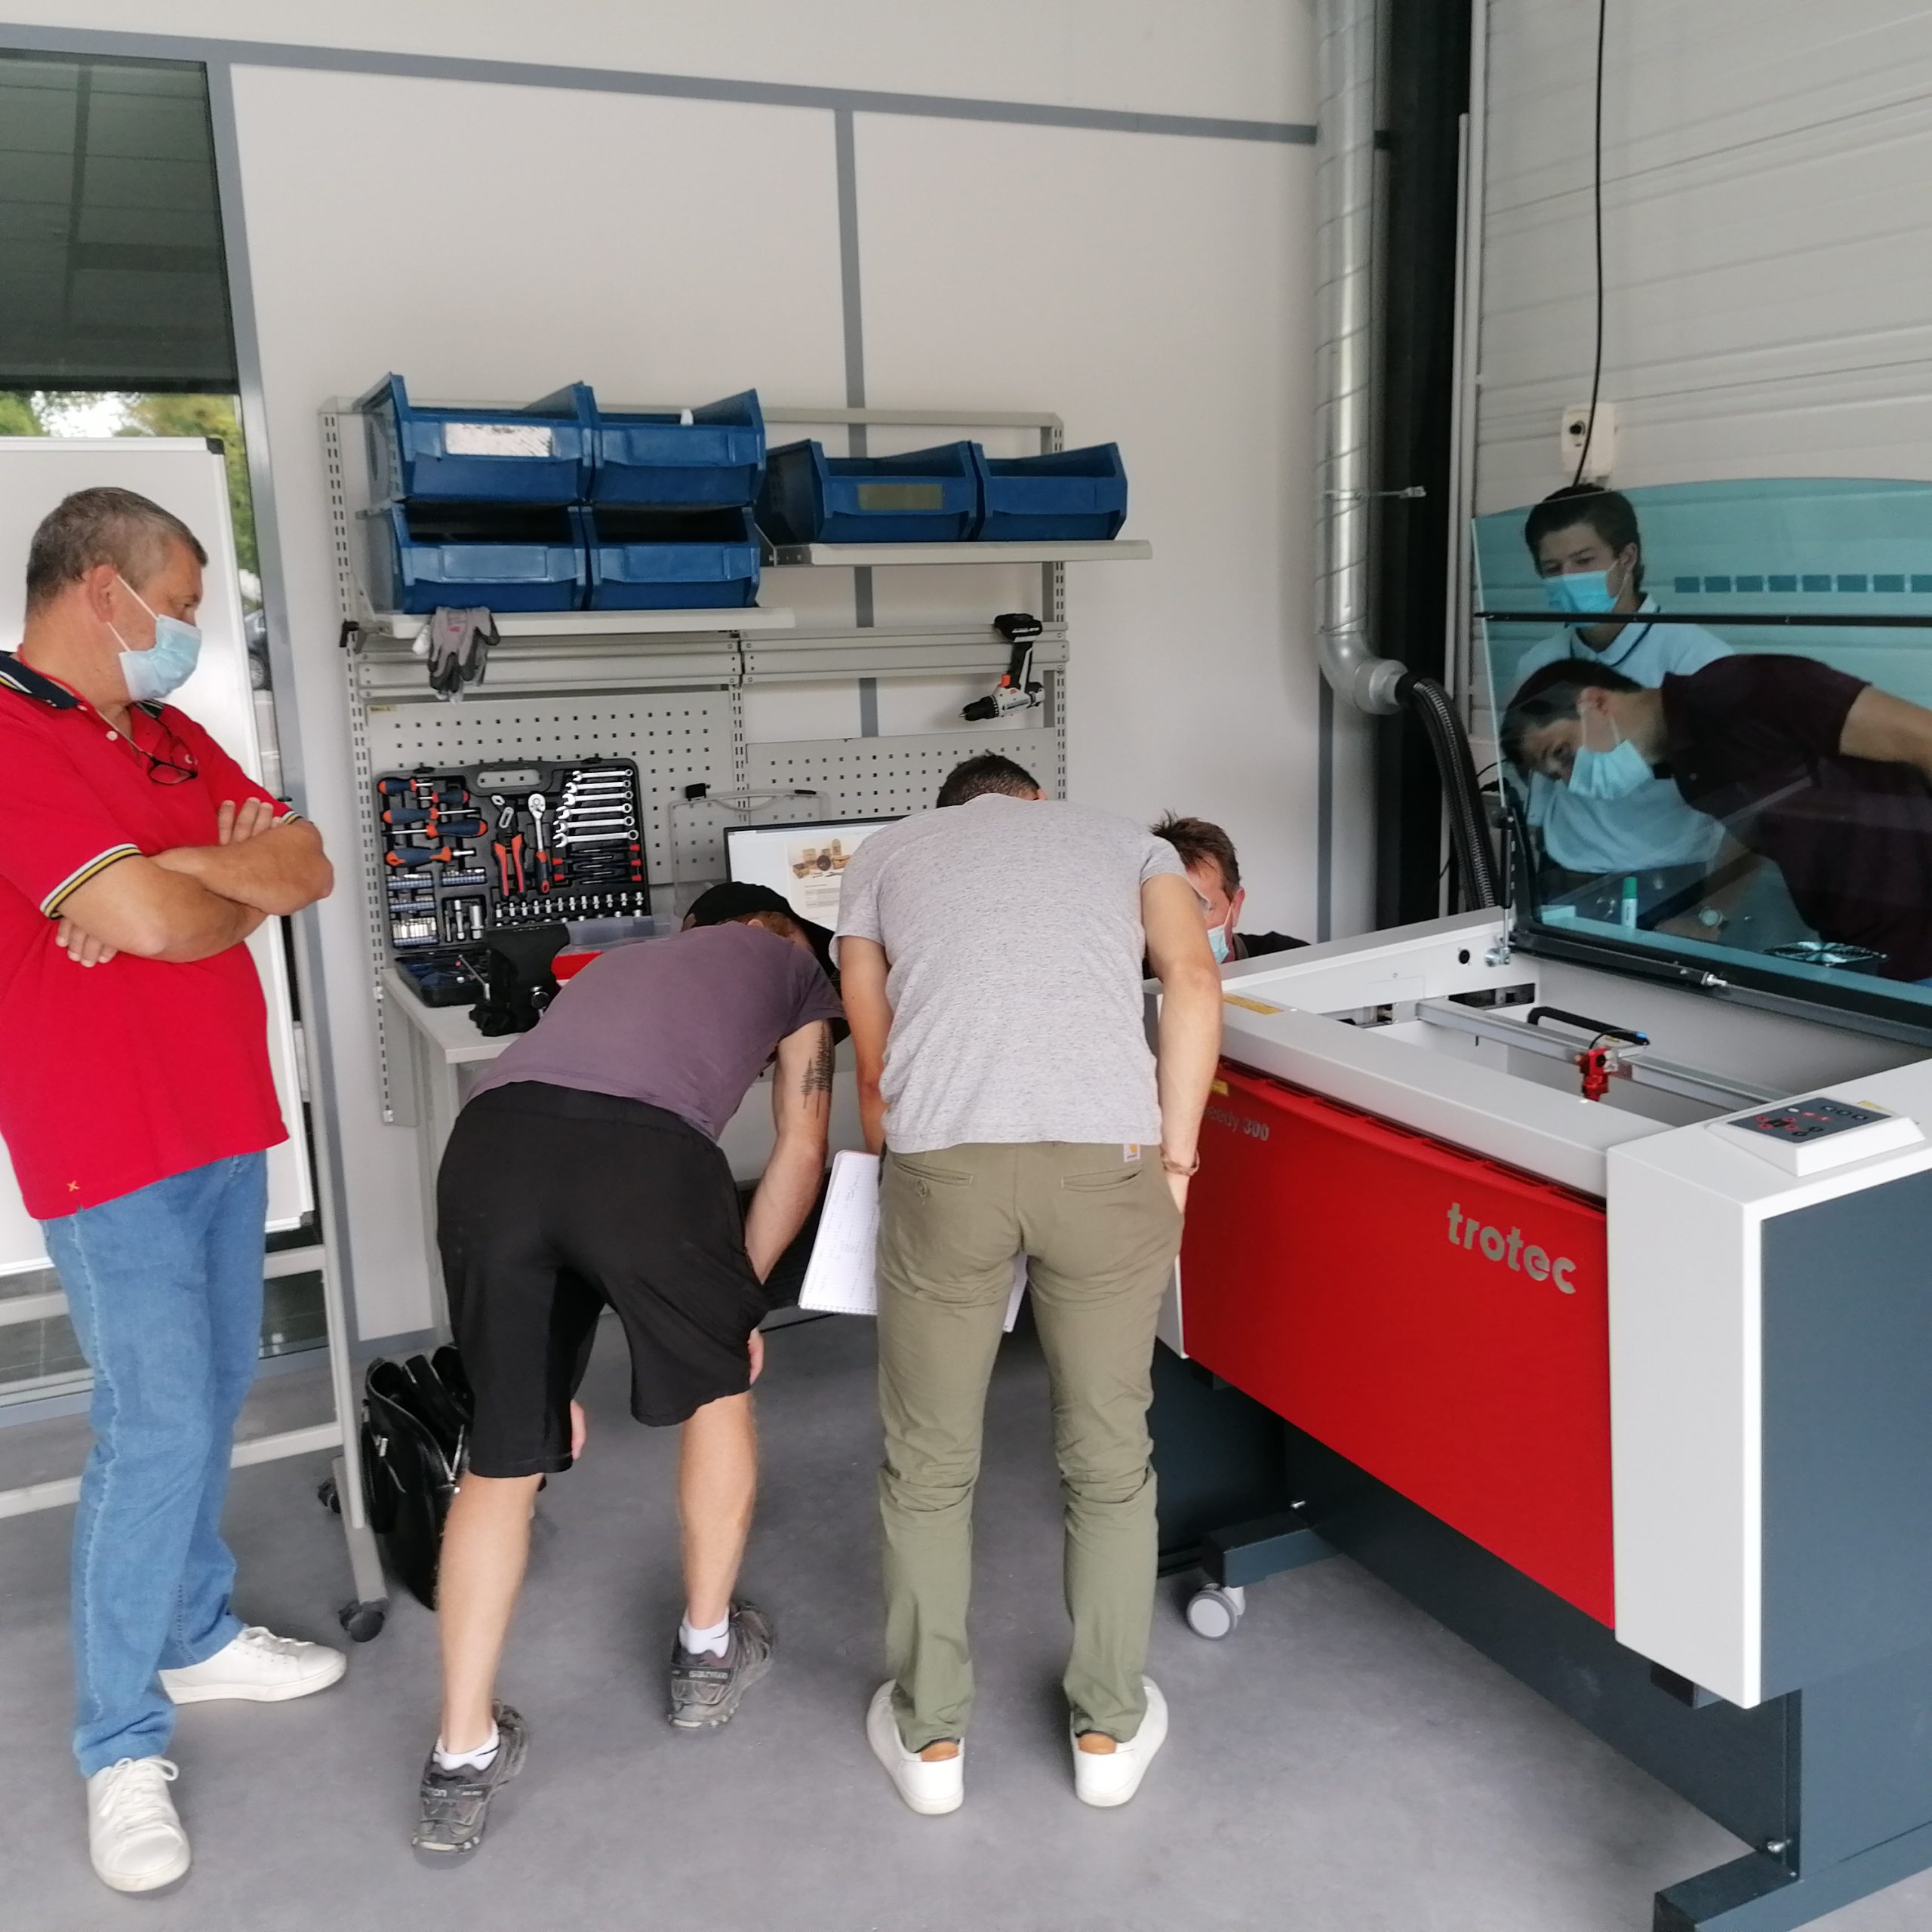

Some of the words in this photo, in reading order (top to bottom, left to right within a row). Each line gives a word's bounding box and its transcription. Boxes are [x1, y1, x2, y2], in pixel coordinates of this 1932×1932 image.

[1205, 1106, 1239, 1132] eedy
[1244, 1118, 1269, 1141] 300
[1447, 1201, 1577, 1294] trotec
